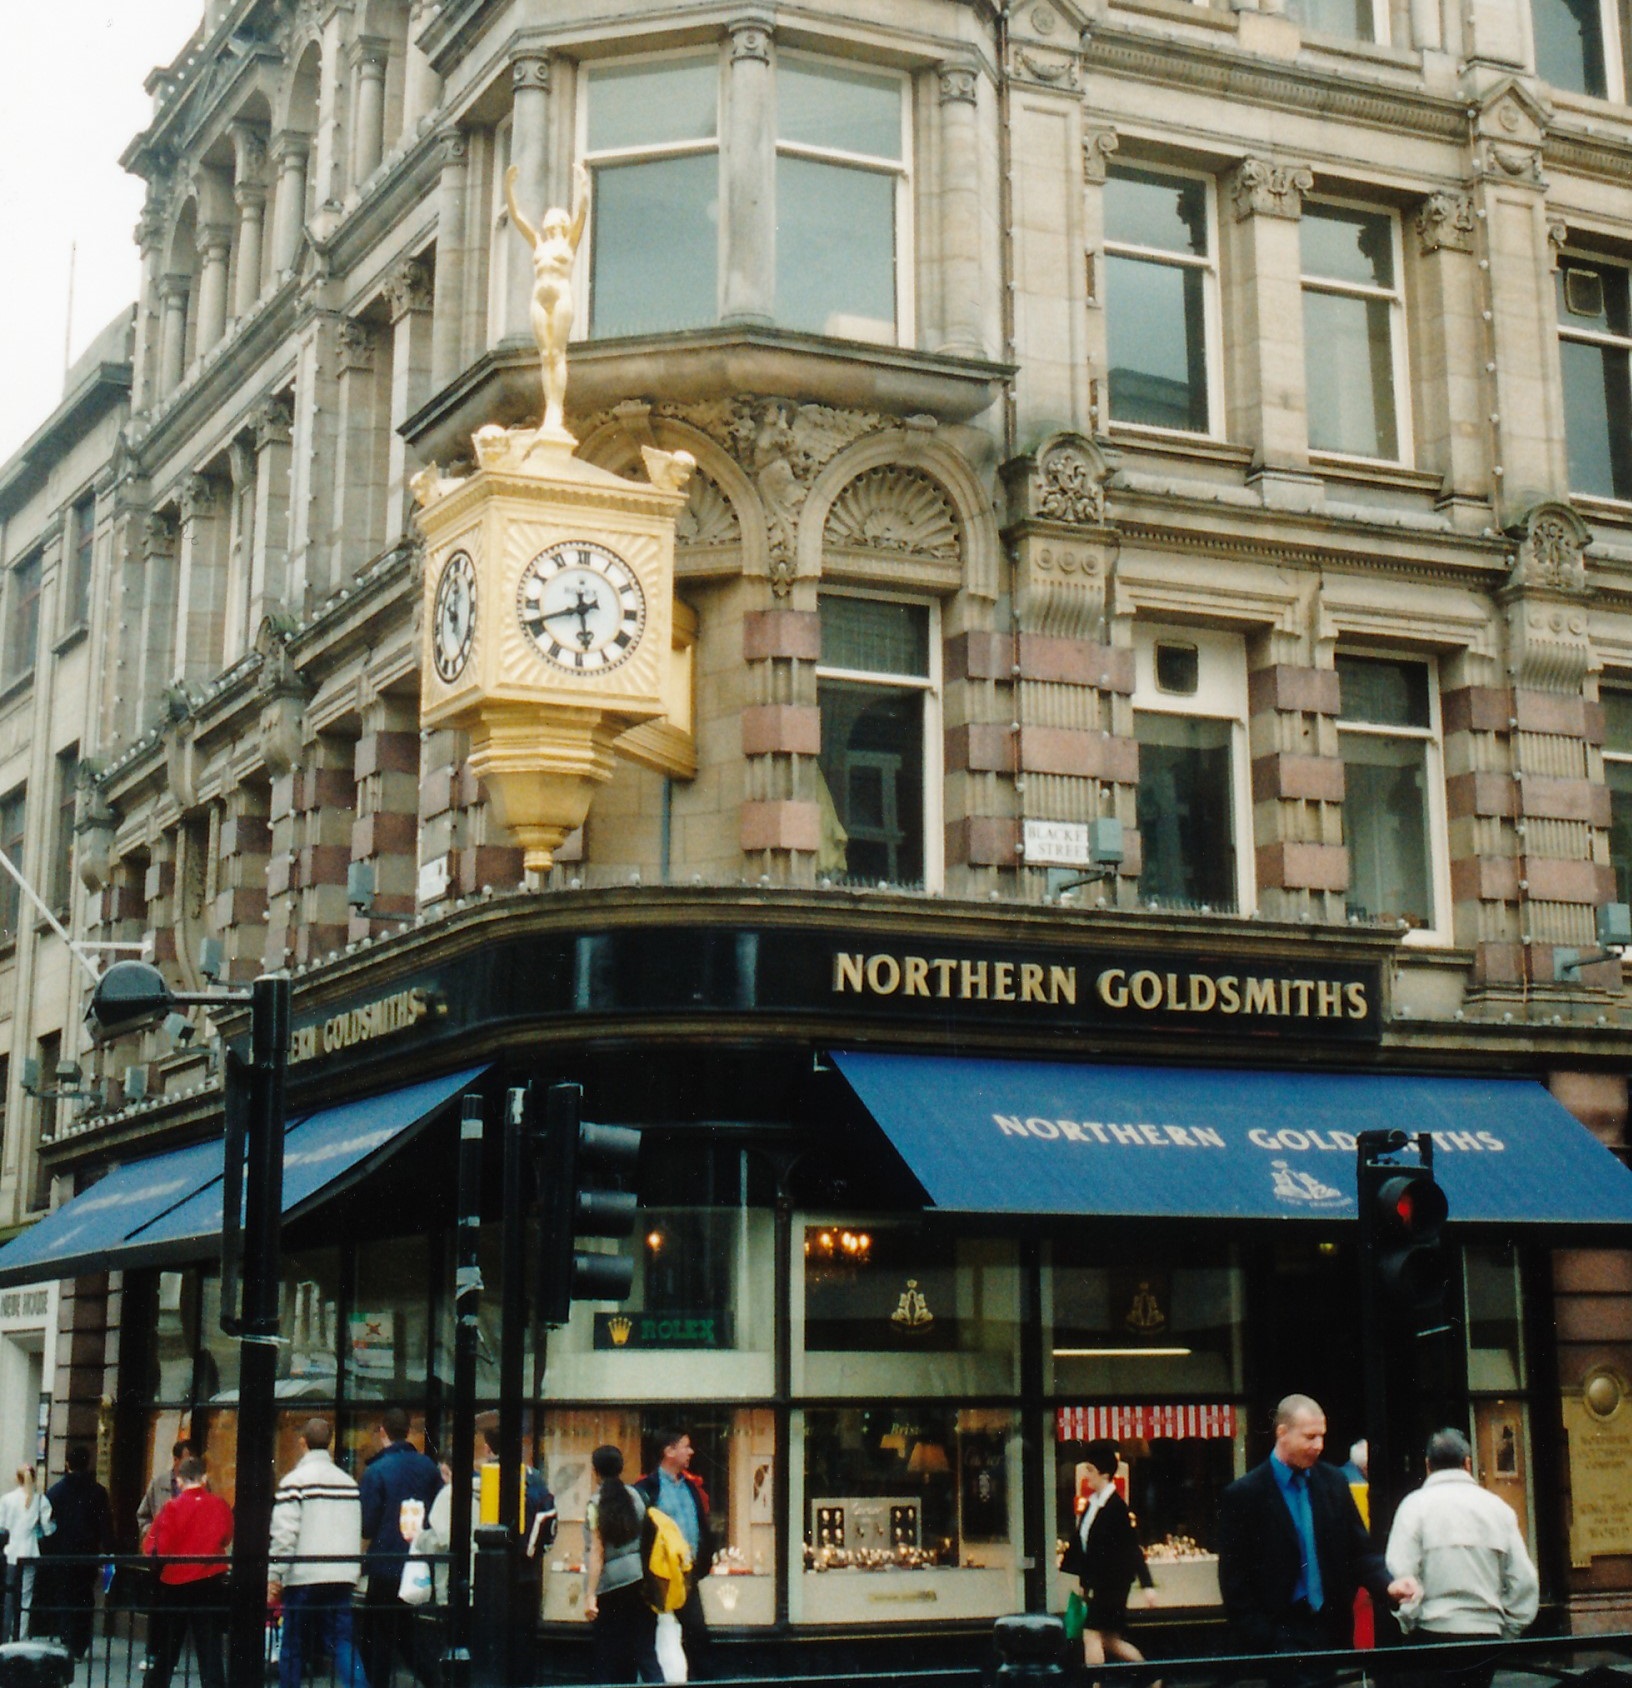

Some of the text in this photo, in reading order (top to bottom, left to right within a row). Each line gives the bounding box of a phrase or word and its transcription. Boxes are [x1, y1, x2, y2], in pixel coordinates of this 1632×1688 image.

[564, 586, 598, 598] ROEX
[1028, 825, 1084, 843] BLACKE
[1038, 841, 1084, 858] STREE
[833, 952, 1368, 1020] NORTHERN GOLDSMITHS
[992, 1113, 1505, 1153] NORTHERN GOLDTHS
[641, 1318, 716, 1342] ROLEX
